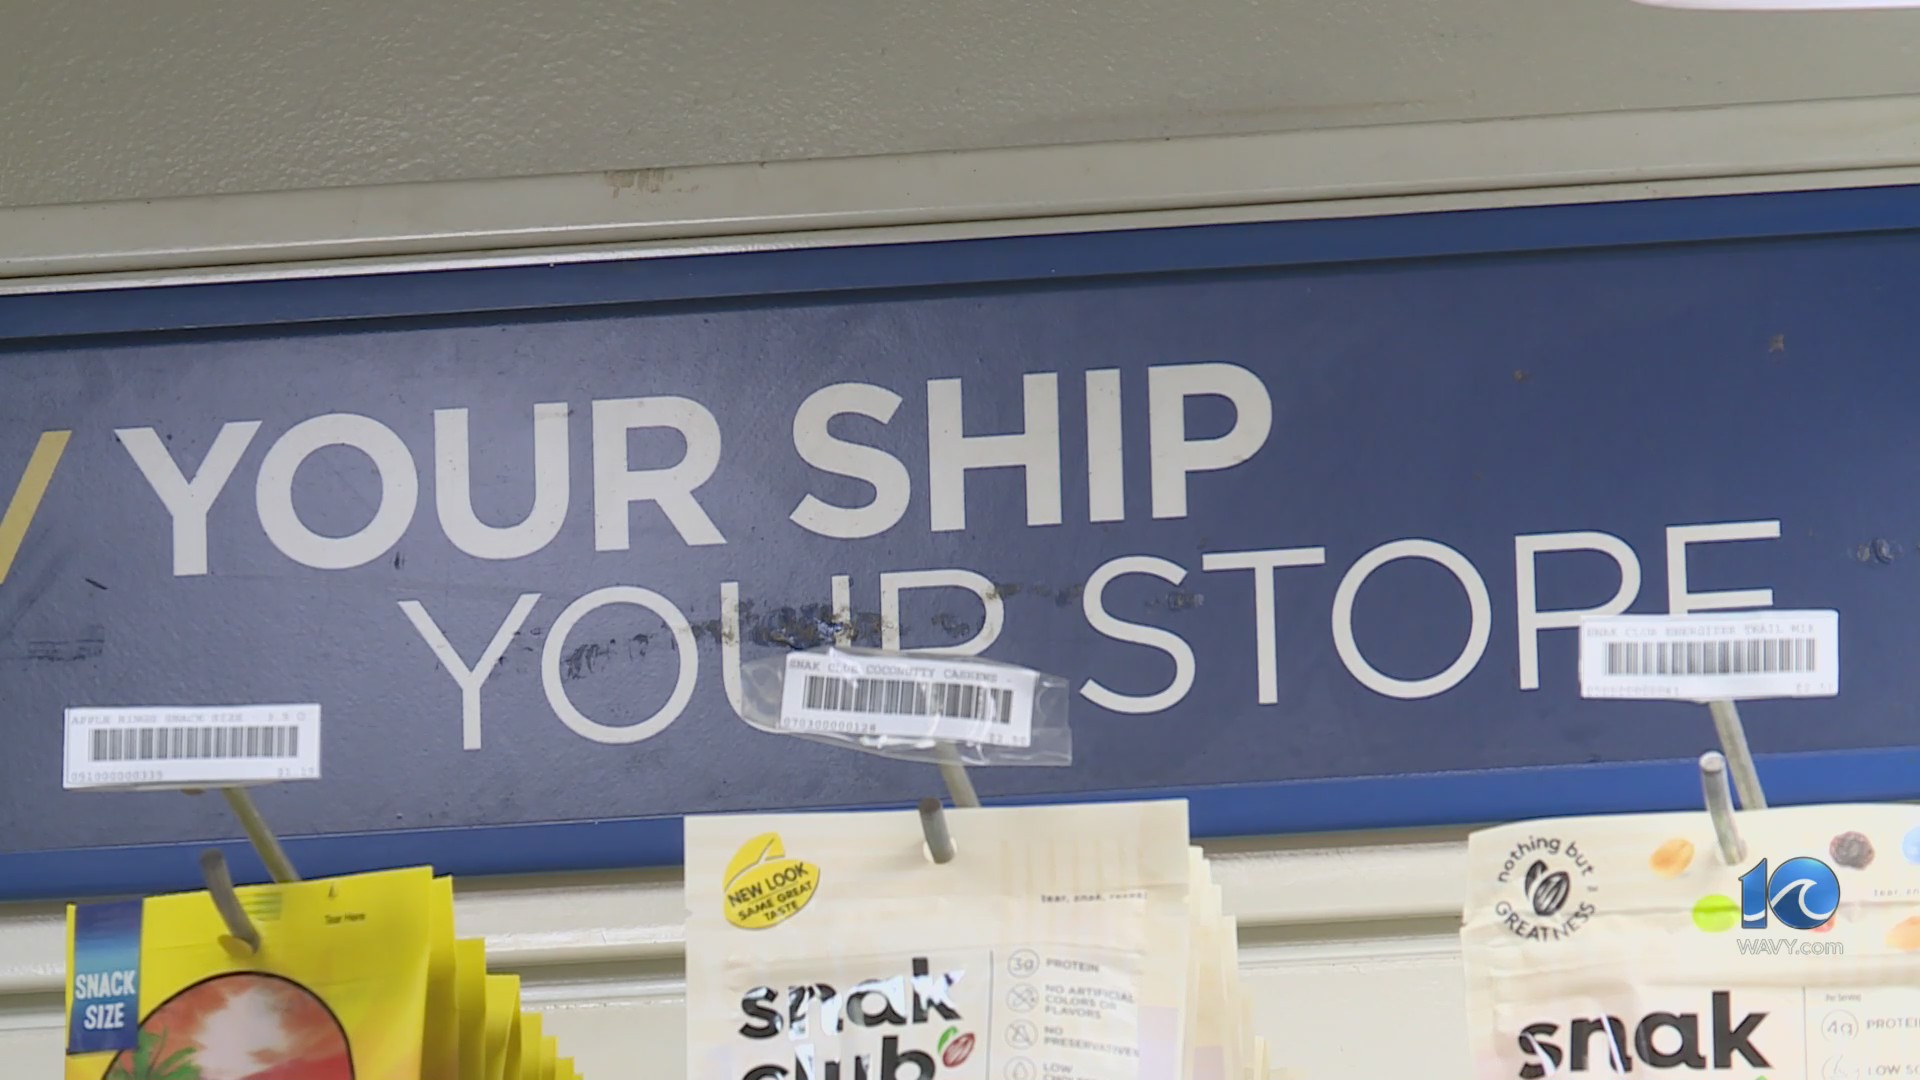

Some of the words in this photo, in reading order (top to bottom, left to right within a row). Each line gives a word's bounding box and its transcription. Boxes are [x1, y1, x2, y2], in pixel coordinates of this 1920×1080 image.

[114, 396, 727, 576] YOUR
[789, 362, 1273, 539] SHIP
[1080, 519, 1781, 714] STORE
[866, 664, 936, 679] COCONUTTY
[71, 714, 111, 725] APPLE
[118, 714, 157, 724] RINGS
[1497, 835, 1561, 883] nothing
[1565, 841, 1595, 877] but
[728, 881, 763, 908] NEW
[765, 861, 809, 891] LOOK
[738, 899, 775, 921] SAME
[777, 880, 813, 905] GREAT
[764, 900, 799, 923] TASTE
[1495, 901, 1596, 942] GREATNESS
[1046, 958, 1100, 974] PROTEIN
[75, 969, 136, 1000] SNACK
[1045, 984, 1065, 996] NO
[1068, 986, 1136, 1005] ARTIFICIAL
[739, 957, 962, 1040] snak
[1045, 995, 1097, 1010] COLORS
[83, 1001, 126, 1030] SIZE
[1045, 1005, 1102, 1020] FLAVORS
[1044, 1025, 1064, 1037] NO
[1517, 991, 1774, 1080] snak
[1043, 1036, 1141, 1059] PRESERVATIVES
[1043, 1062, 1074, 1075] LOW
